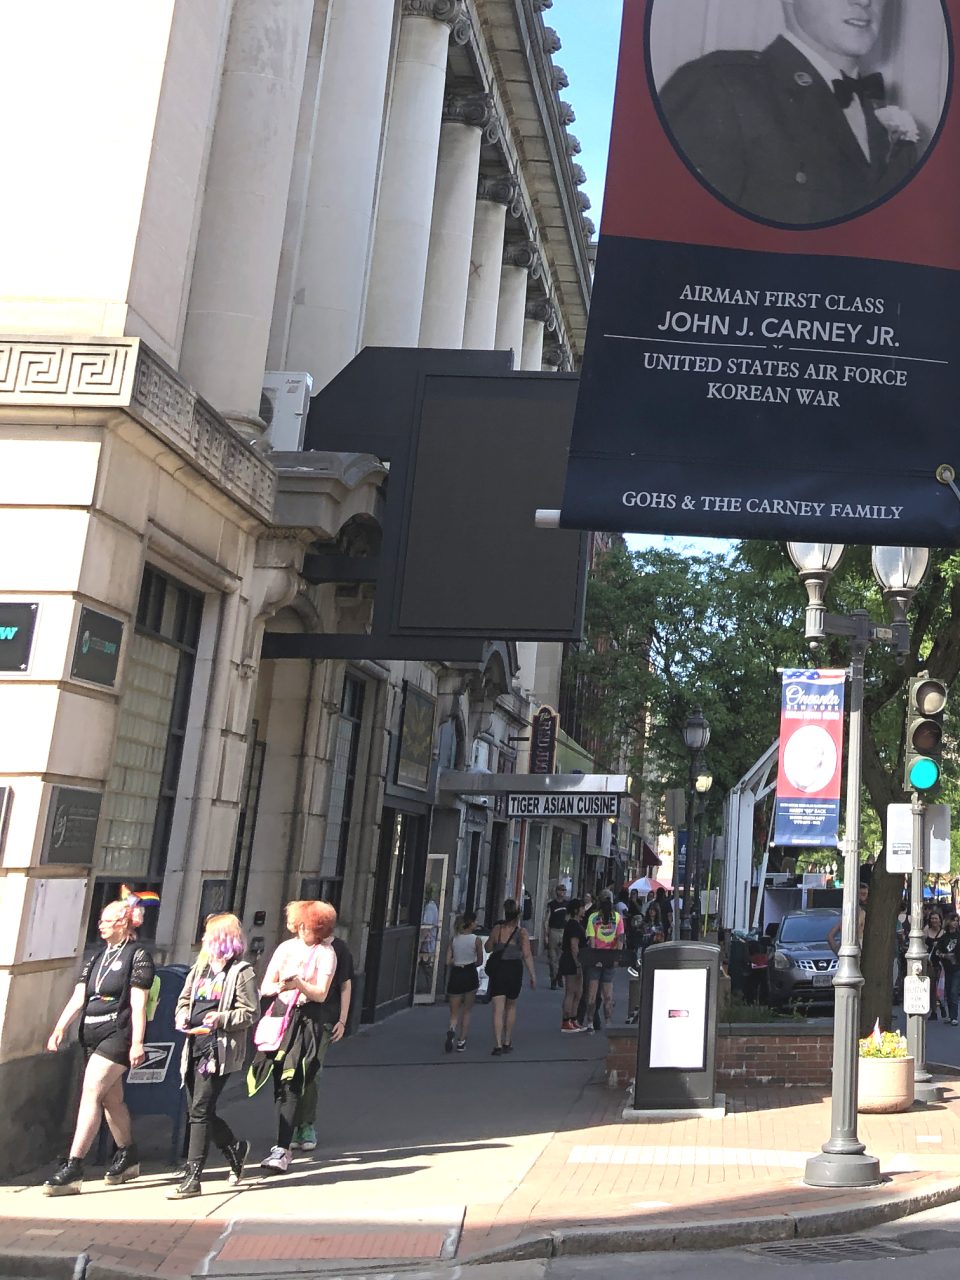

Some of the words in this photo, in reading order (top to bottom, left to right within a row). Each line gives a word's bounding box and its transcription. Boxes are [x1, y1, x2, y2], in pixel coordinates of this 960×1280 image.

[680, 284, 760, 306] AIRMAN
[764, 291, 821, 309] FIRST
[825, 294, 885, 314] CLASS
[657, 311, 730, 335] JOHN
[735, 317, 754, 336] J.
[761, 317, 863, 343] CARNEY
[866, 325, 900, 347] JR.
[643, 352, 722, 373] UNITED
[727, 358, 800, 378] STATES
[804, 363, 839, 381] AIR
[843, 366, 908, 387] FORCE
[706, 382, 791, 404] KOREAN
[795, 388, 841, 407] WAR
[622, 491, 677, 509] GOHS
[681, 495, 697, 510] &
[700, 496, 742, 512] THE
[746, 498, 826, 517] CARNEY
[830, 503, 904, 519] FAMILY
[510, 797, 540, 814] TIGER
[543, 797, 574, 814] ASIAN
[577, 797, 616, 814] CUISINE
